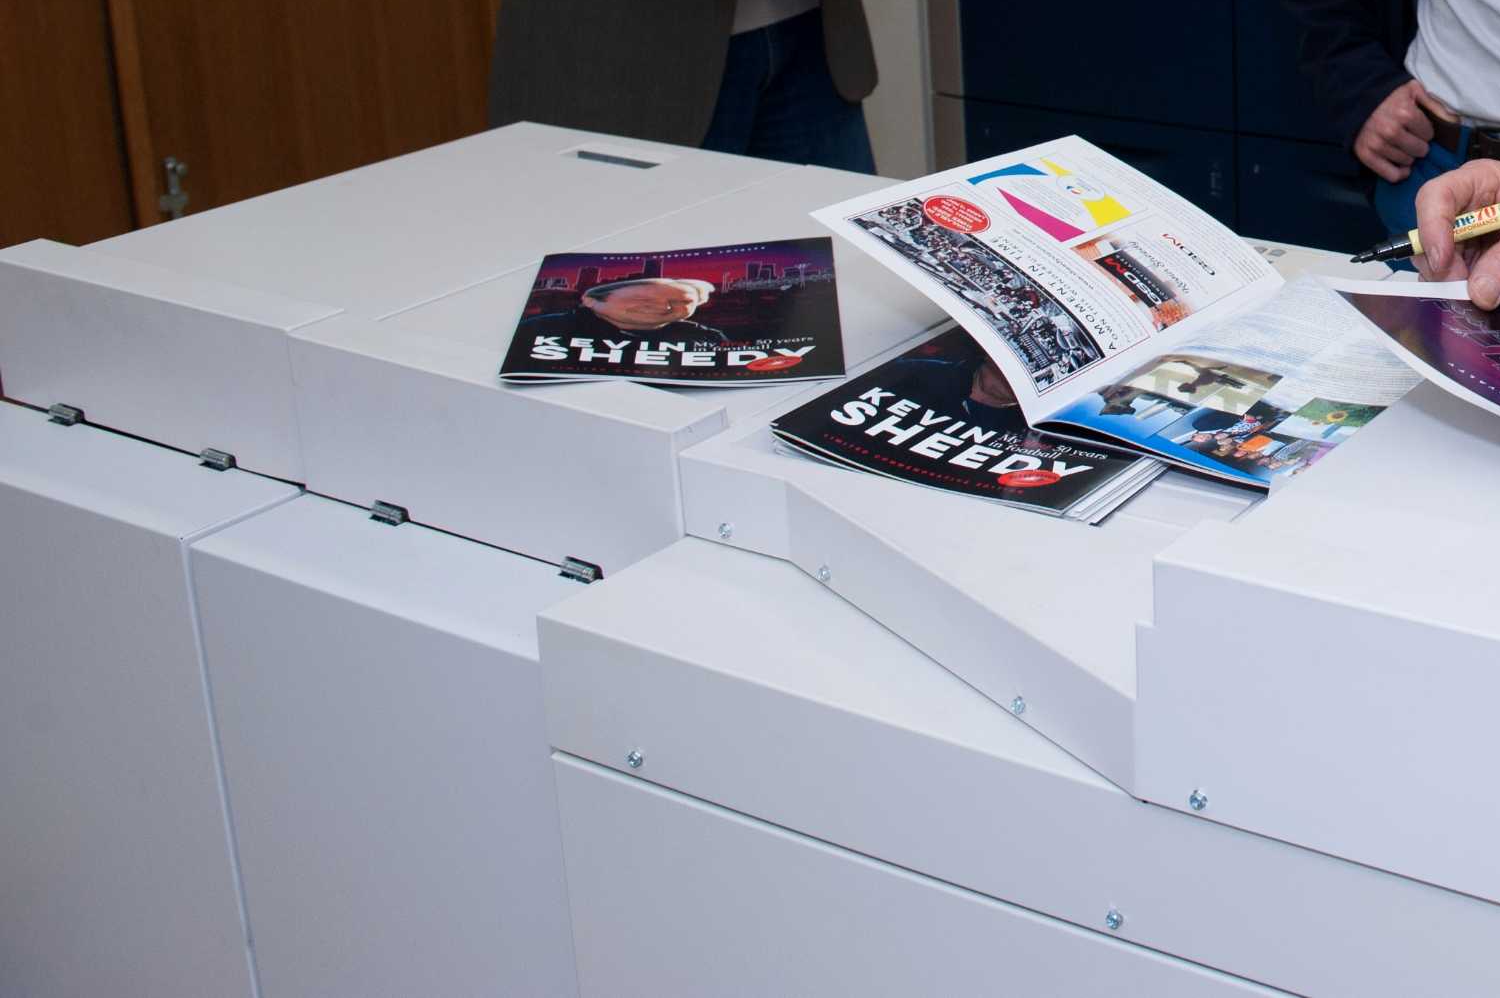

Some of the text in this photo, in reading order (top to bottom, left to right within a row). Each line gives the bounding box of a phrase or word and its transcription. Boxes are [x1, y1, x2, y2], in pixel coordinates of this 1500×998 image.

[992, 237, 1022, 261] TIME
[1162, 233, 1216, 276] GSDM
[1030, 265, 1044, 277] IN
[1103, 257, 1162, 305] GSDM
[1049, 282, 1105, 335] MOMENT
[1100, 318, 1118, 340] OWN
[534, 335, 688, 352] KEVIN
[693, 340, 717, 349] My
[775, 336, 815, 345] years
[712, 343, 771, 352] football
[530, 344, 817, 368] SHEEDY
[858, 386, 997, 445] KEVIN
[830, 400, 1095, 478] SHEEDY
[988, 439, 1062, 460] in football
[1000, 433, 1019, 448] My
[1054, 443, 1073, 454] 50
[1069, 447, 1109, 461] years
